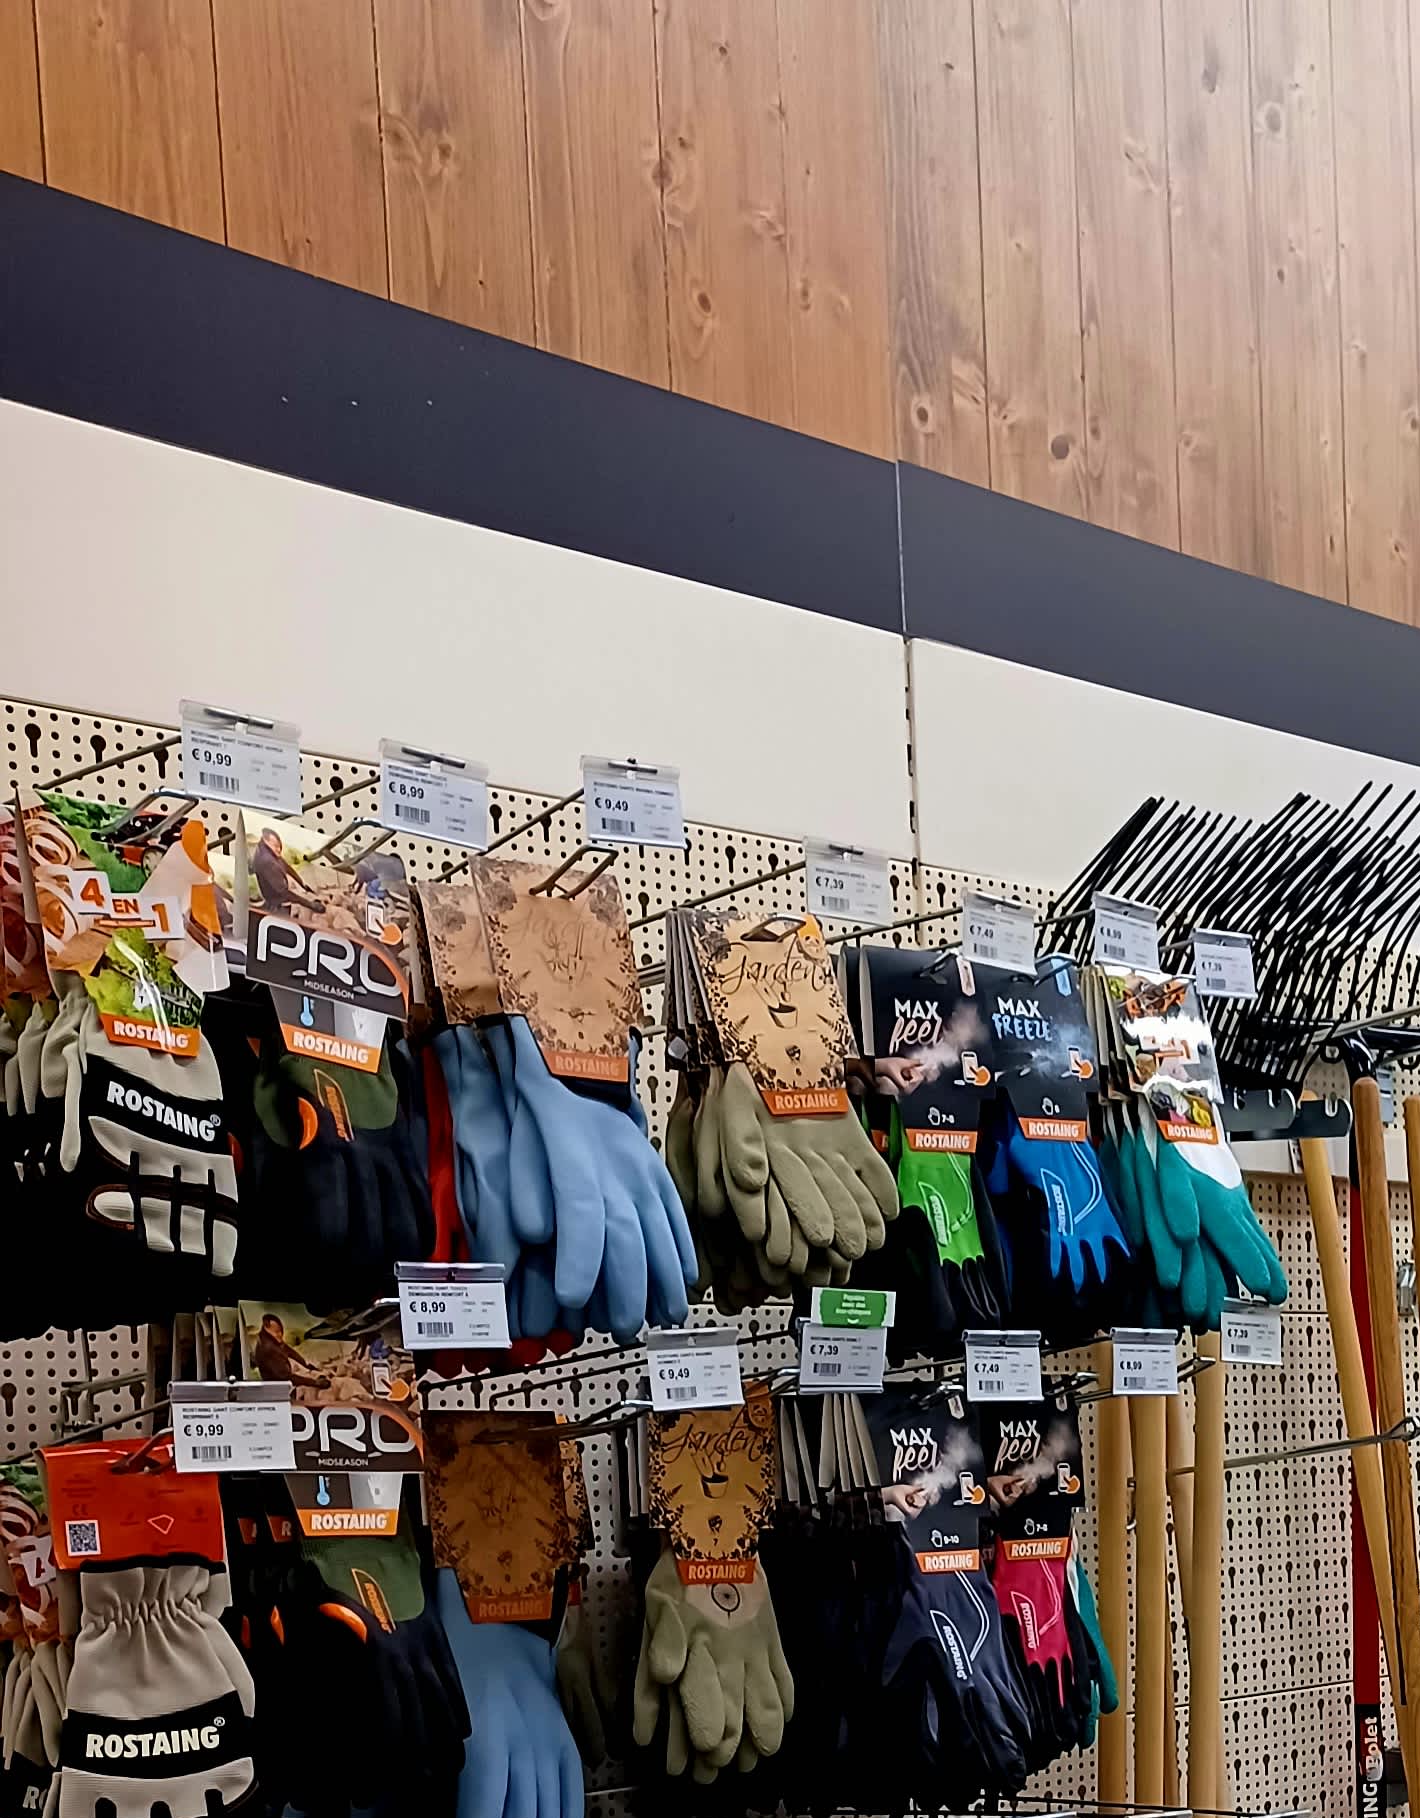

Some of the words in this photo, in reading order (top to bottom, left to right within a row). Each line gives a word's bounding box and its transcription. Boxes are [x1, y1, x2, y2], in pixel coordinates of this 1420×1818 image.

[191, 748, 200, 761] €
[202, 749, 232, 768] 9,99
[398, 784, 424, 799] 8,99
[604, 798, 629, 812] 9,49
[825, 877, 844, 891] 7,39
[80, 878, 105, 906] 4
[112, 899, 139, 914] EN
[152, 903, 169, 932] 1
[257, 915, 400, 996] PRO
[304, 979, 354, 999] MIDSEASON
[894, 998, 941, 1020] MAX
[997, 997, 1042, 1019] MAX
[114, 1020, 190, 1048] ROSTAING
[992, 1012, 1052, 1042] FREEZE
[293, 1031, 369, 1063] ROSTAING
[555, 1056, 619, 1077] ROSTAING
[775, 1092, 839, 1110] ROSTAING
[1028, 1122, 1080, 1138] ROSTAING
[1167, 1124, 1214, 1141] ROSTAING
[915, 1133, 970, 1150] ROSTAING
[410, 1301, 417, 1312] €
[419, 1301, 446, 1315] 8,99
[817, 1345, 838, 1356] 7,39
[667, 1368, 689, 1381] 9,49
[981, 1363, 999, 1374] 7,49
[184, 1425, 192, 1436] €
[195, 1425, 224, 1438] 9,99
[889, 1427, 934, 1447] MAX
[1000, 1420, 1037, 1439] MAX
[318, 1458, 369, 1468] MIDSEASON
[311, 1513, 388, 1531] ROSTAING
[1011, 1541, 1062, 1557] ROSTAING
[925, 1554, 973, 1570] ROSTAING
[687, 1564, 748, 1580] ROSTAING
[478, 1600, 545, 1618] ROSTAING
